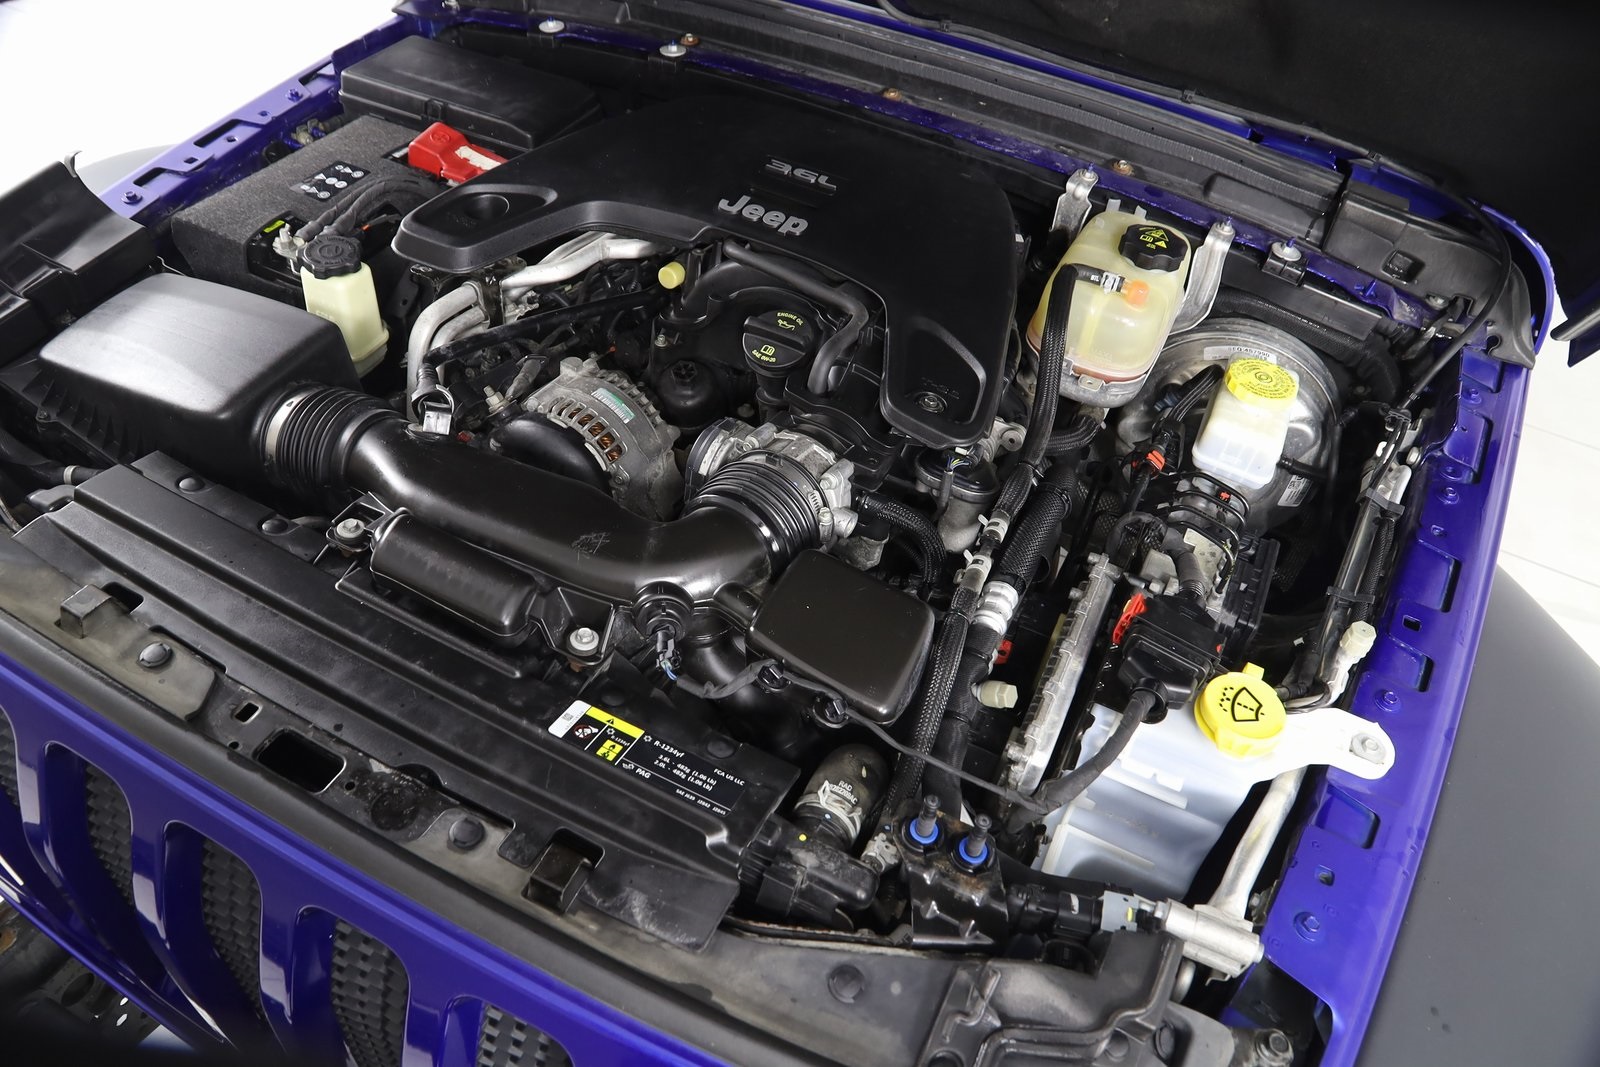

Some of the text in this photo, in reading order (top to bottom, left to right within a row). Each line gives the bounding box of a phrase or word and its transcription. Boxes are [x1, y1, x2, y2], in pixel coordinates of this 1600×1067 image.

[718, 195, 808, 236] Jeep
[777, 312, 797, 320] ENGINE
[653, 740, 685, 758] R-1234yf
[635, 767, 651, 779] PAG
[653, 760, 666, 769] 2.0L
[687, 776, 703, 786] (1.06
[703, 782, 713, 791] Lb)
[691, 770, 707, 781] (1.06
[707, 777, 717, 786] Lb)
[713, 768, 725, 777] FCA
[734, 778, 745, 786] LLC
[838, 780, 853, 791] RAD
